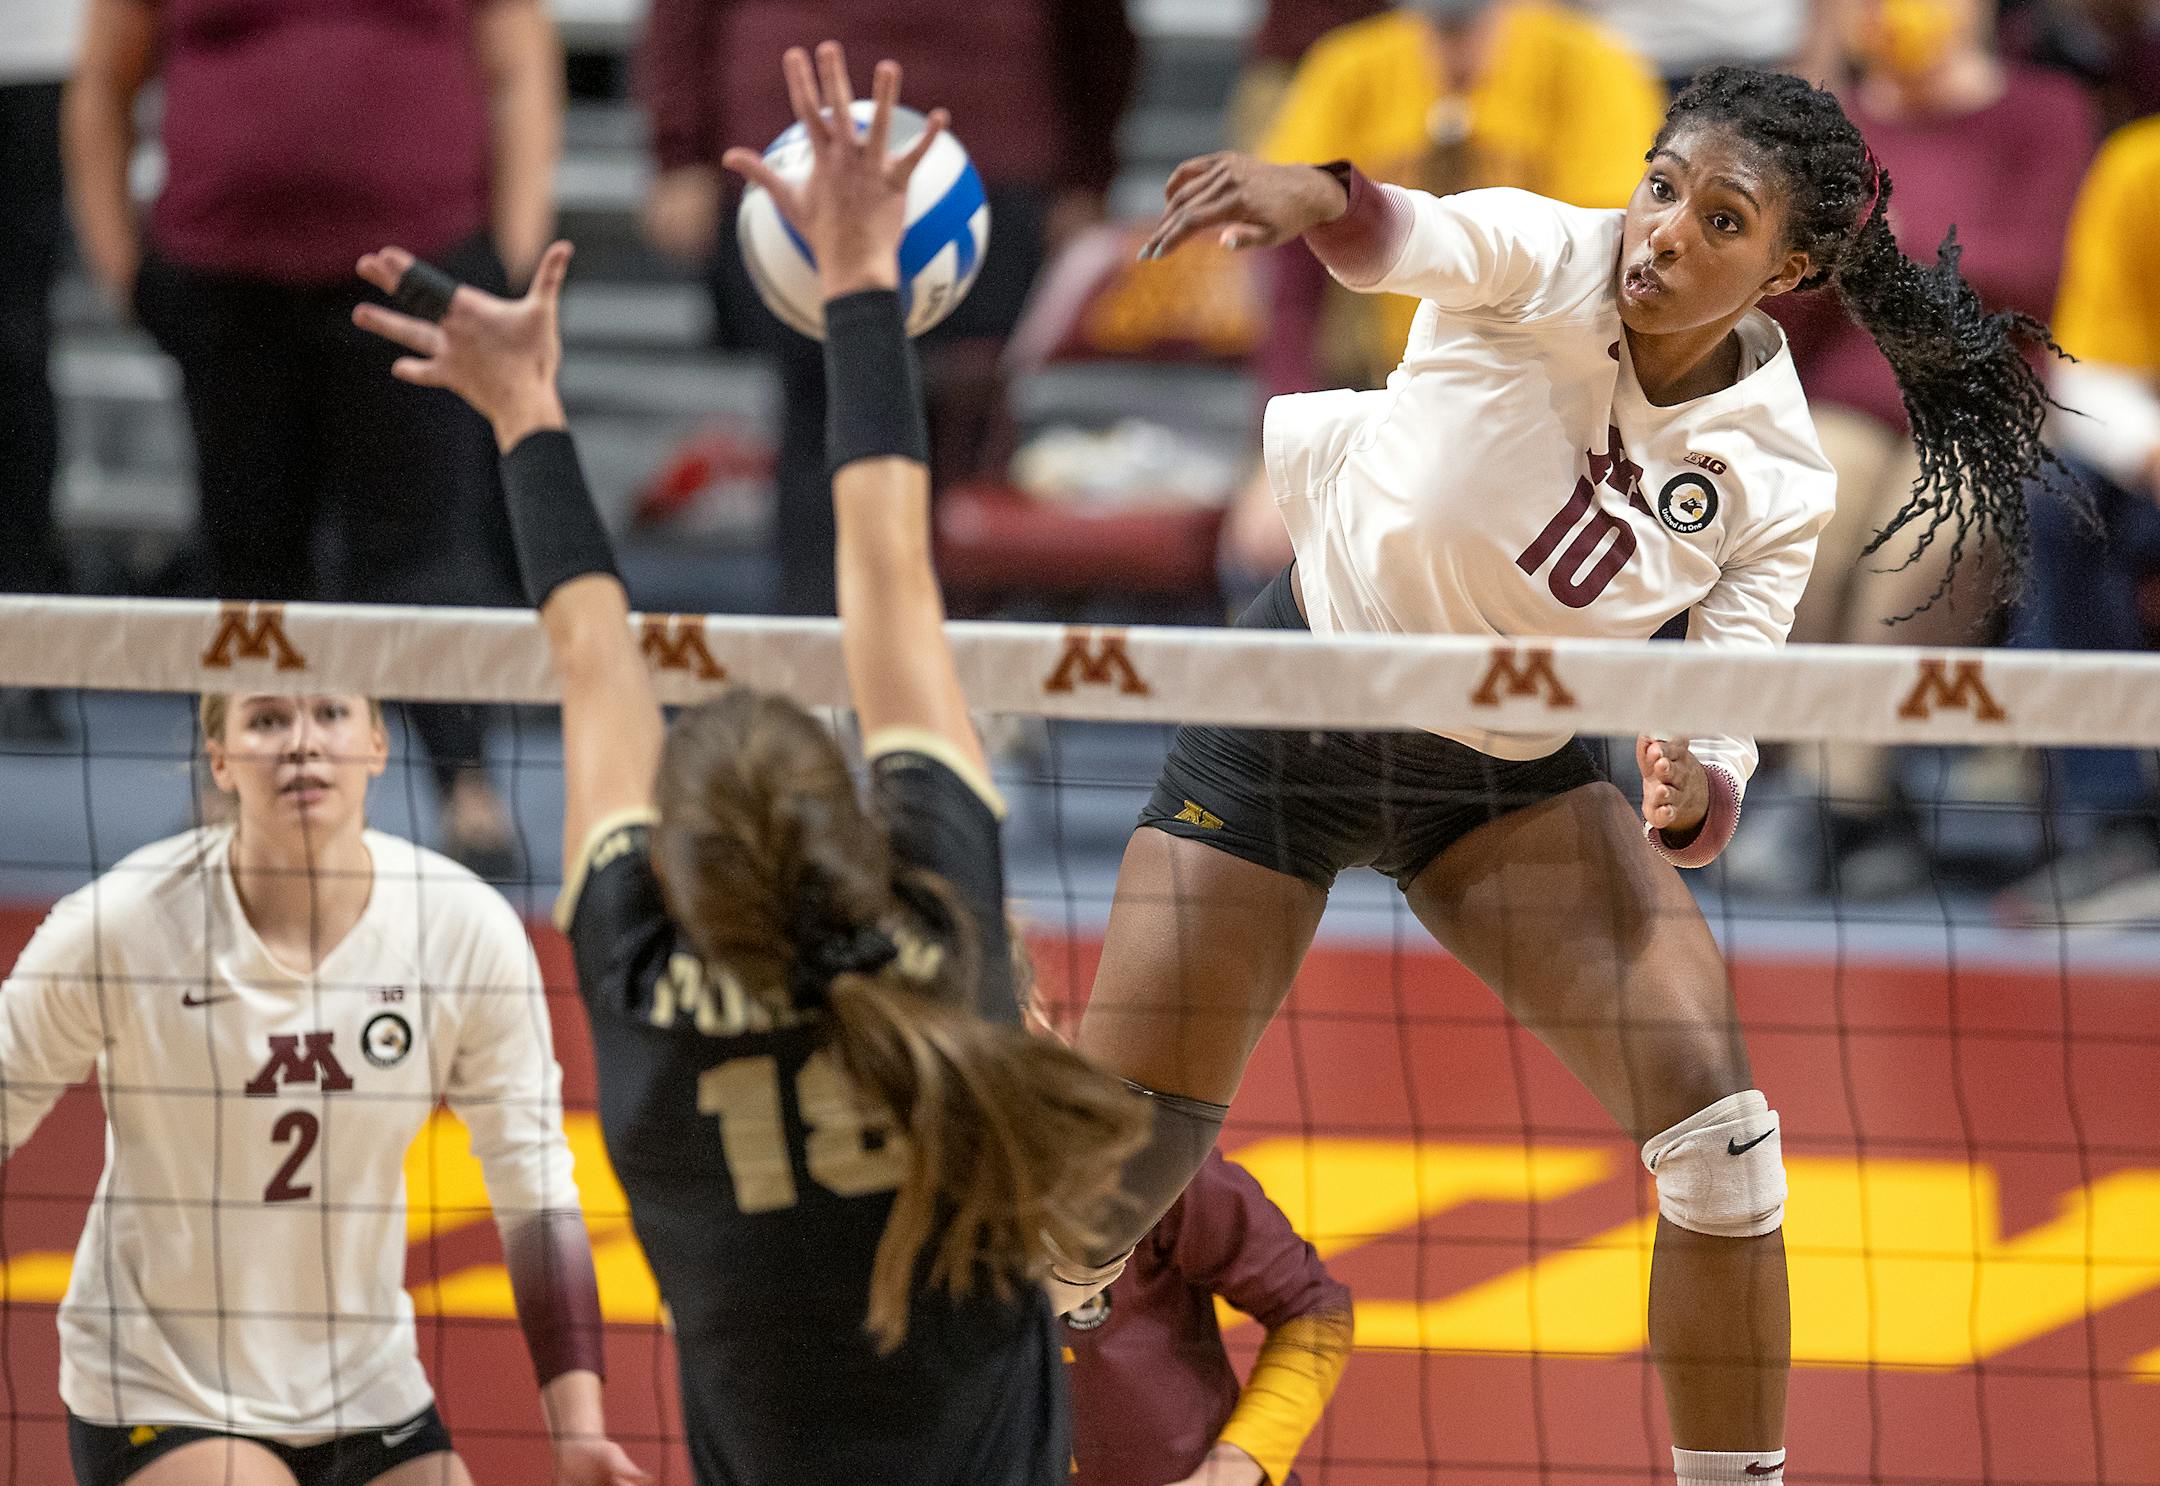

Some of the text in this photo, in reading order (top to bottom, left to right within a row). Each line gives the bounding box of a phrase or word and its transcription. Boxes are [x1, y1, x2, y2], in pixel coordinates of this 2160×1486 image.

[1515, 474, 1637, 609] 10
[1661, 508, 1703, 532] United As One
[202, 602, 306, 671] M
[640, 614, 727, 682] M
[1044, 627, 1149, 696] M
[1471, 645, 1576, 709] M
[1898, 659, 2007, 723] M
[245, 1032, 354, 1097] M
[263, 1109, 319, 1203] 2
